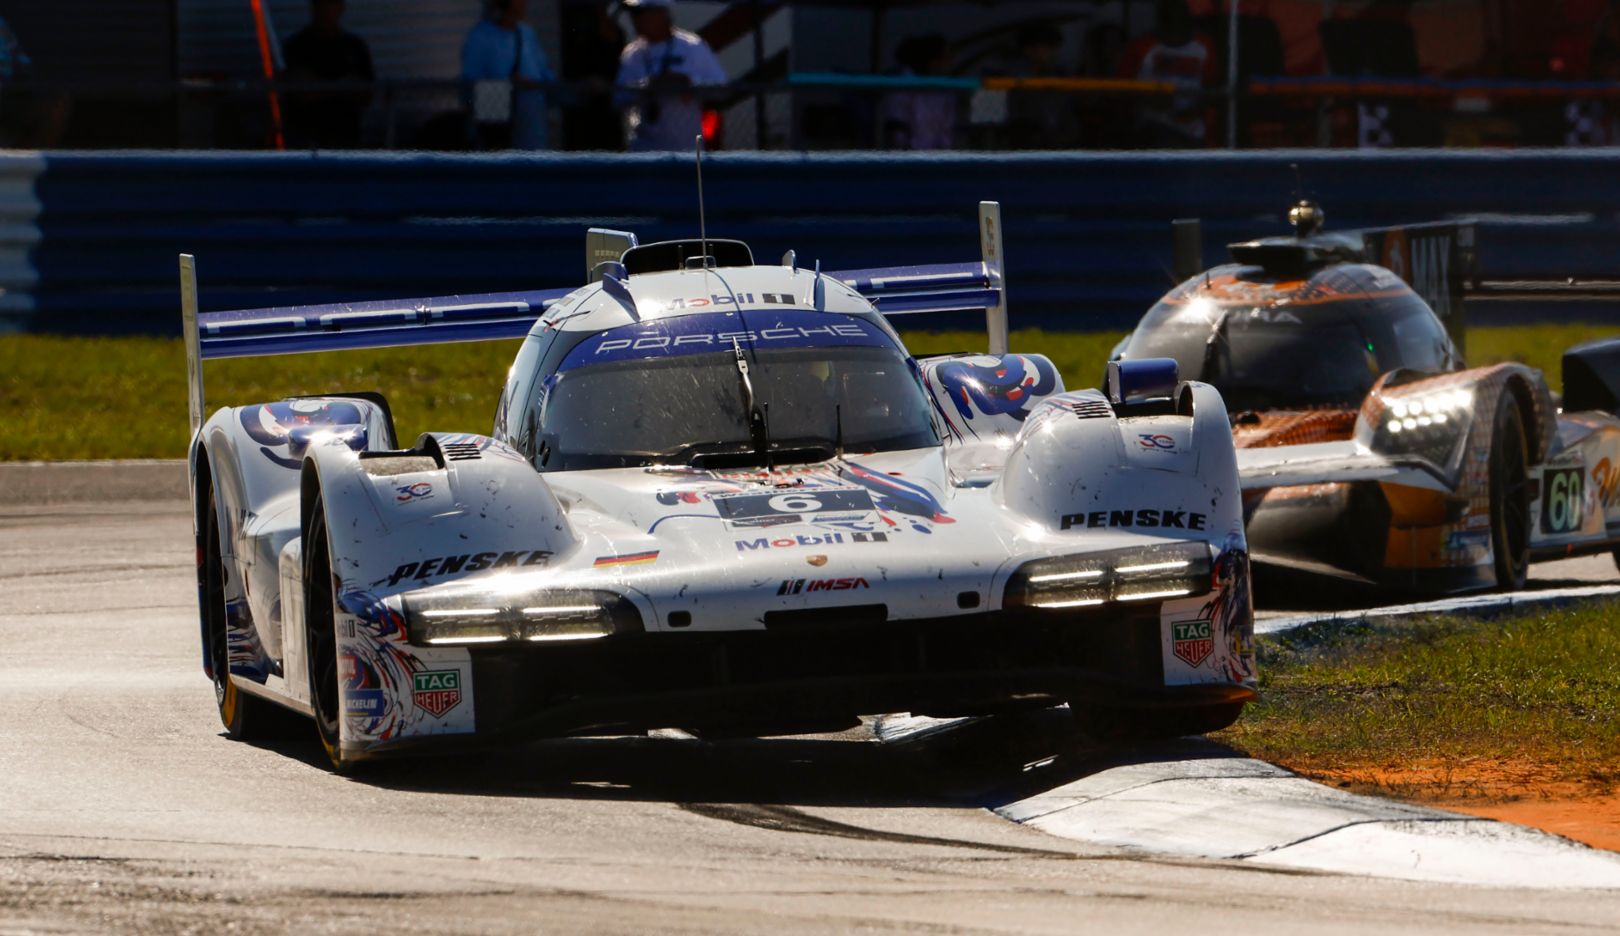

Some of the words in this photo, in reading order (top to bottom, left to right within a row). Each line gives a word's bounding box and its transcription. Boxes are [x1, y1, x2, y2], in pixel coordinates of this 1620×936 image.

[665, 293, 755, 311] Mobil
[595, 324, 868, 354] PORSCHE
[768, 494, 822, 513] 6
[1549, 470, 1582, 531] 60
[1060, 509, 1207, 532] PENSKE
[735, 533, 845, 550] Mobil
[387, 550, 555, 587] PENSKE
[806, 576, 870, 593] IMSA
[1176, 624, 1209, 639] TAG
[1176, 640, 1212, 663] HEUER
[417, 674, 456, 689] TAG
[415, 691, 459, 713] HEUER
